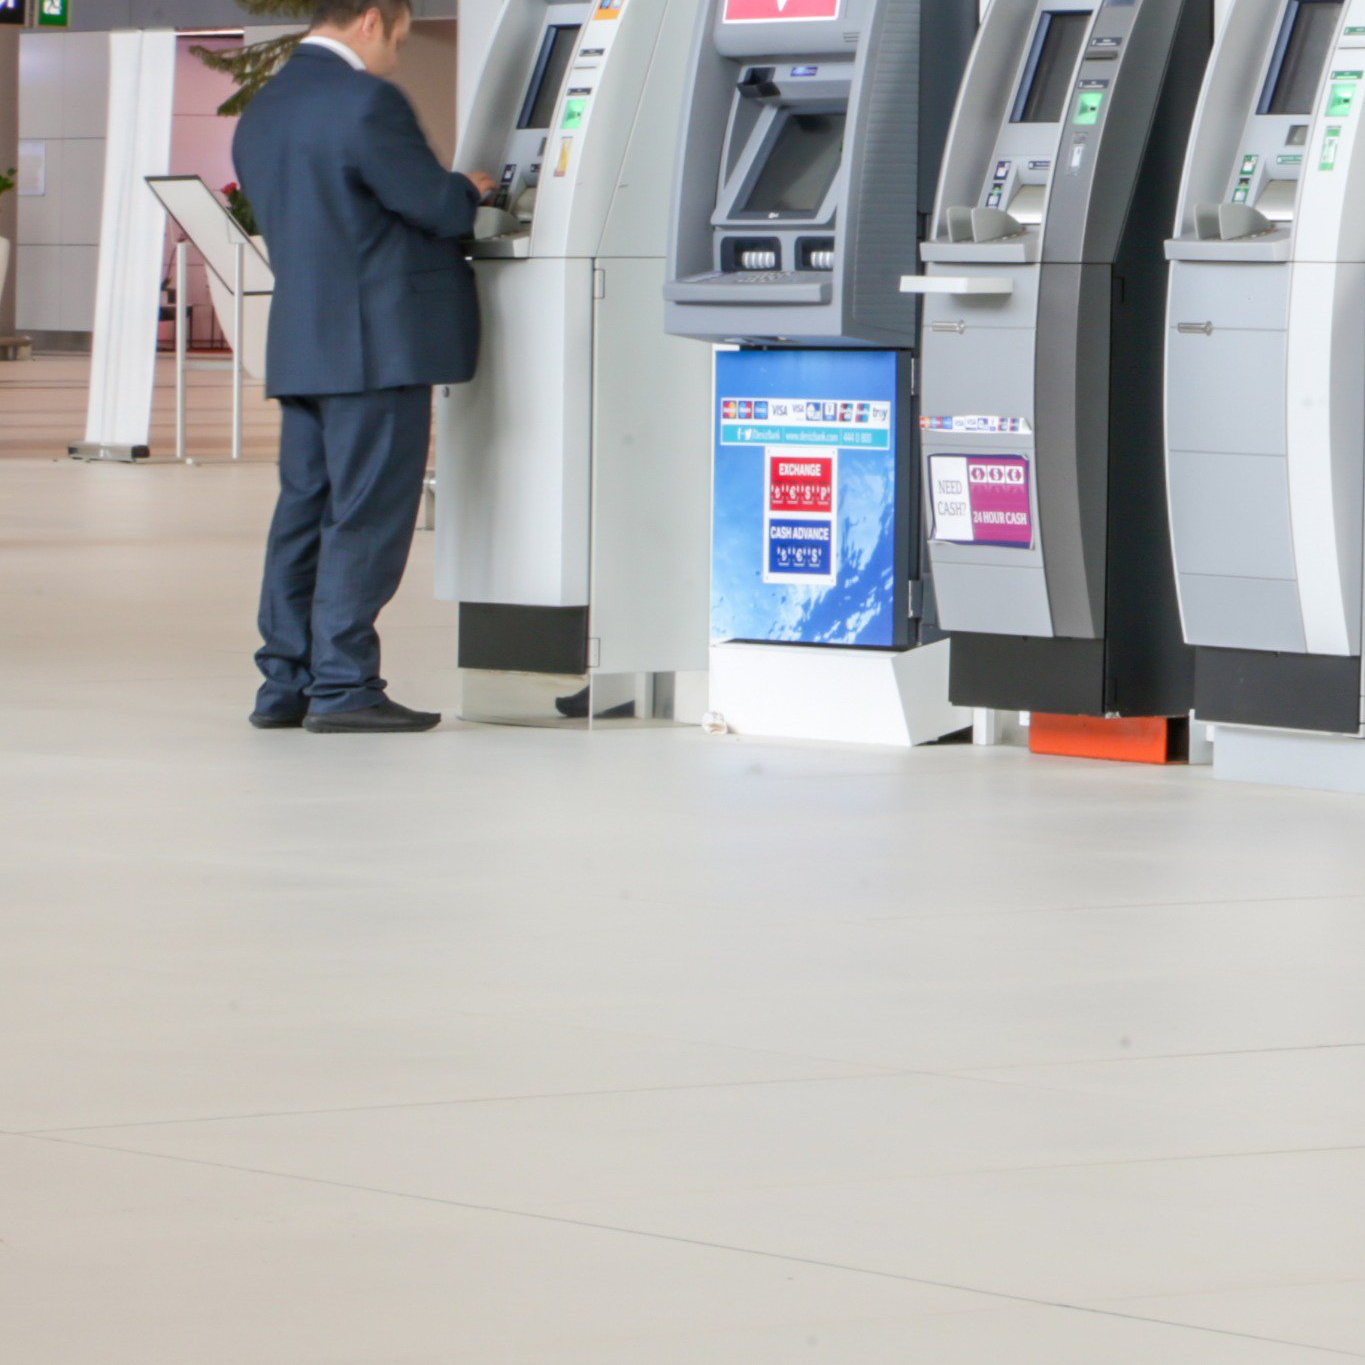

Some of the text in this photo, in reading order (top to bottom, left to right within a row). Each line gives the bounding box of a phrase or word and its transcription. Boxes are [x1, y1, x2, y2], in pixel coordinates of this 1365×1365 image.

[779, 463, 821, 476] EXCHANGE
[938, 480, 963, 495] NEED
[973, 511, 1027, 525] 24 HOUR CASH
[770, 526, 829, 541] CASH ADVANCE
